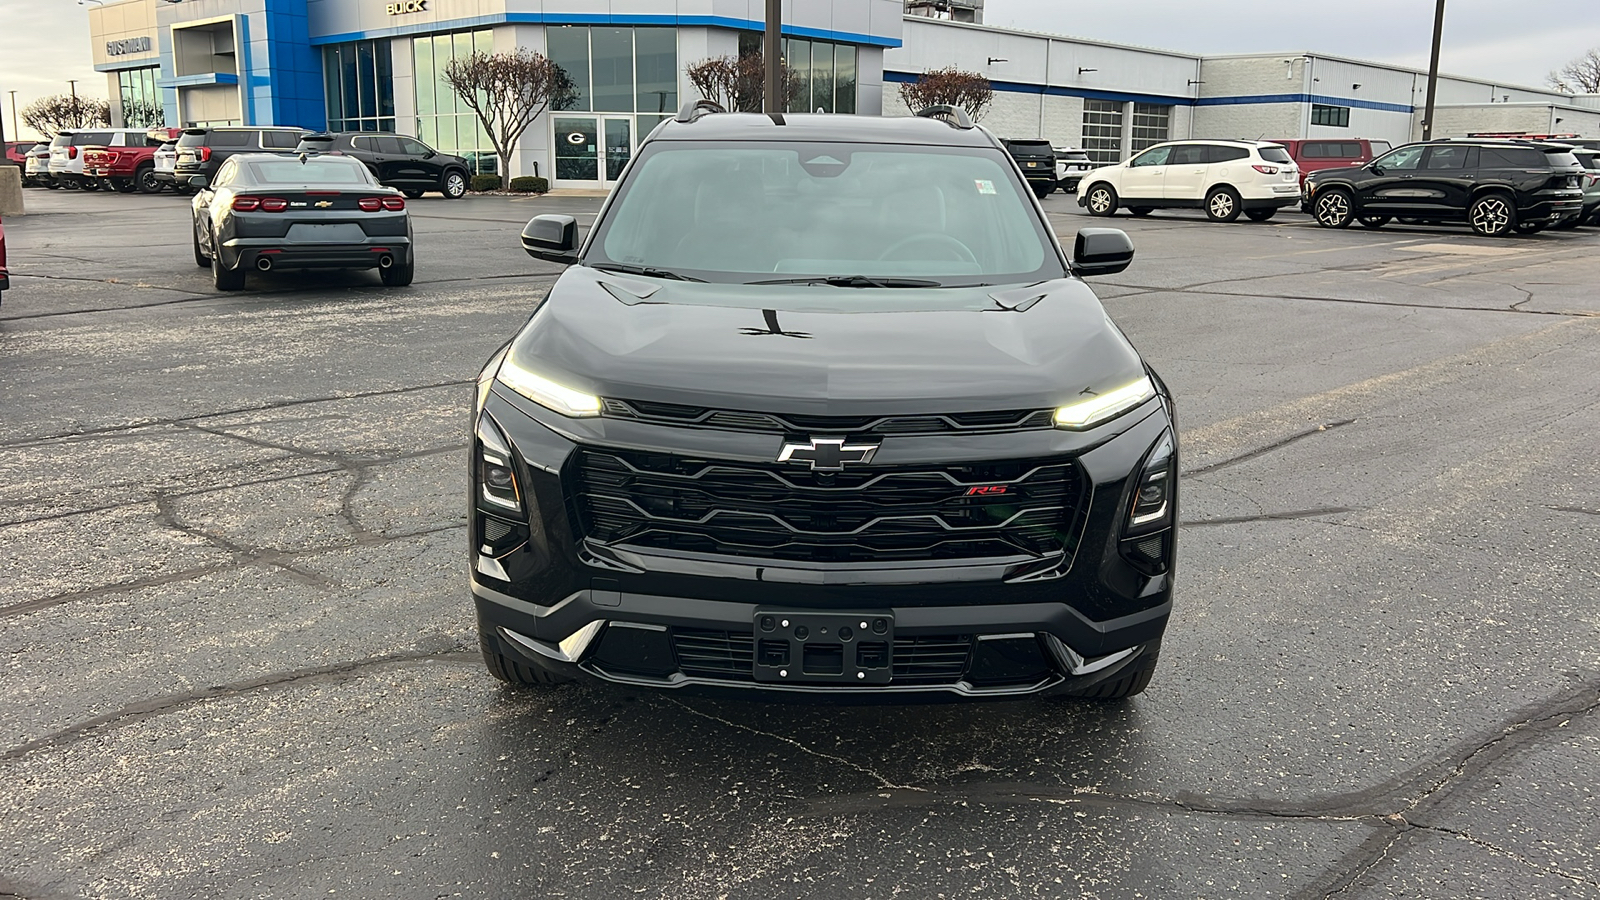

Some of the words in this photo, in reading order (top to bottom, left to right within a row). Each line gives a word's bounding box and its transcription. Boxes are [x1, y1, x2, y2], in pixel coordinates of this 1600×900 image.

[386, 0, 425, 15] BUICK
[567, 132, 585, 144] G
[966, 485, 1008, 495] RS
